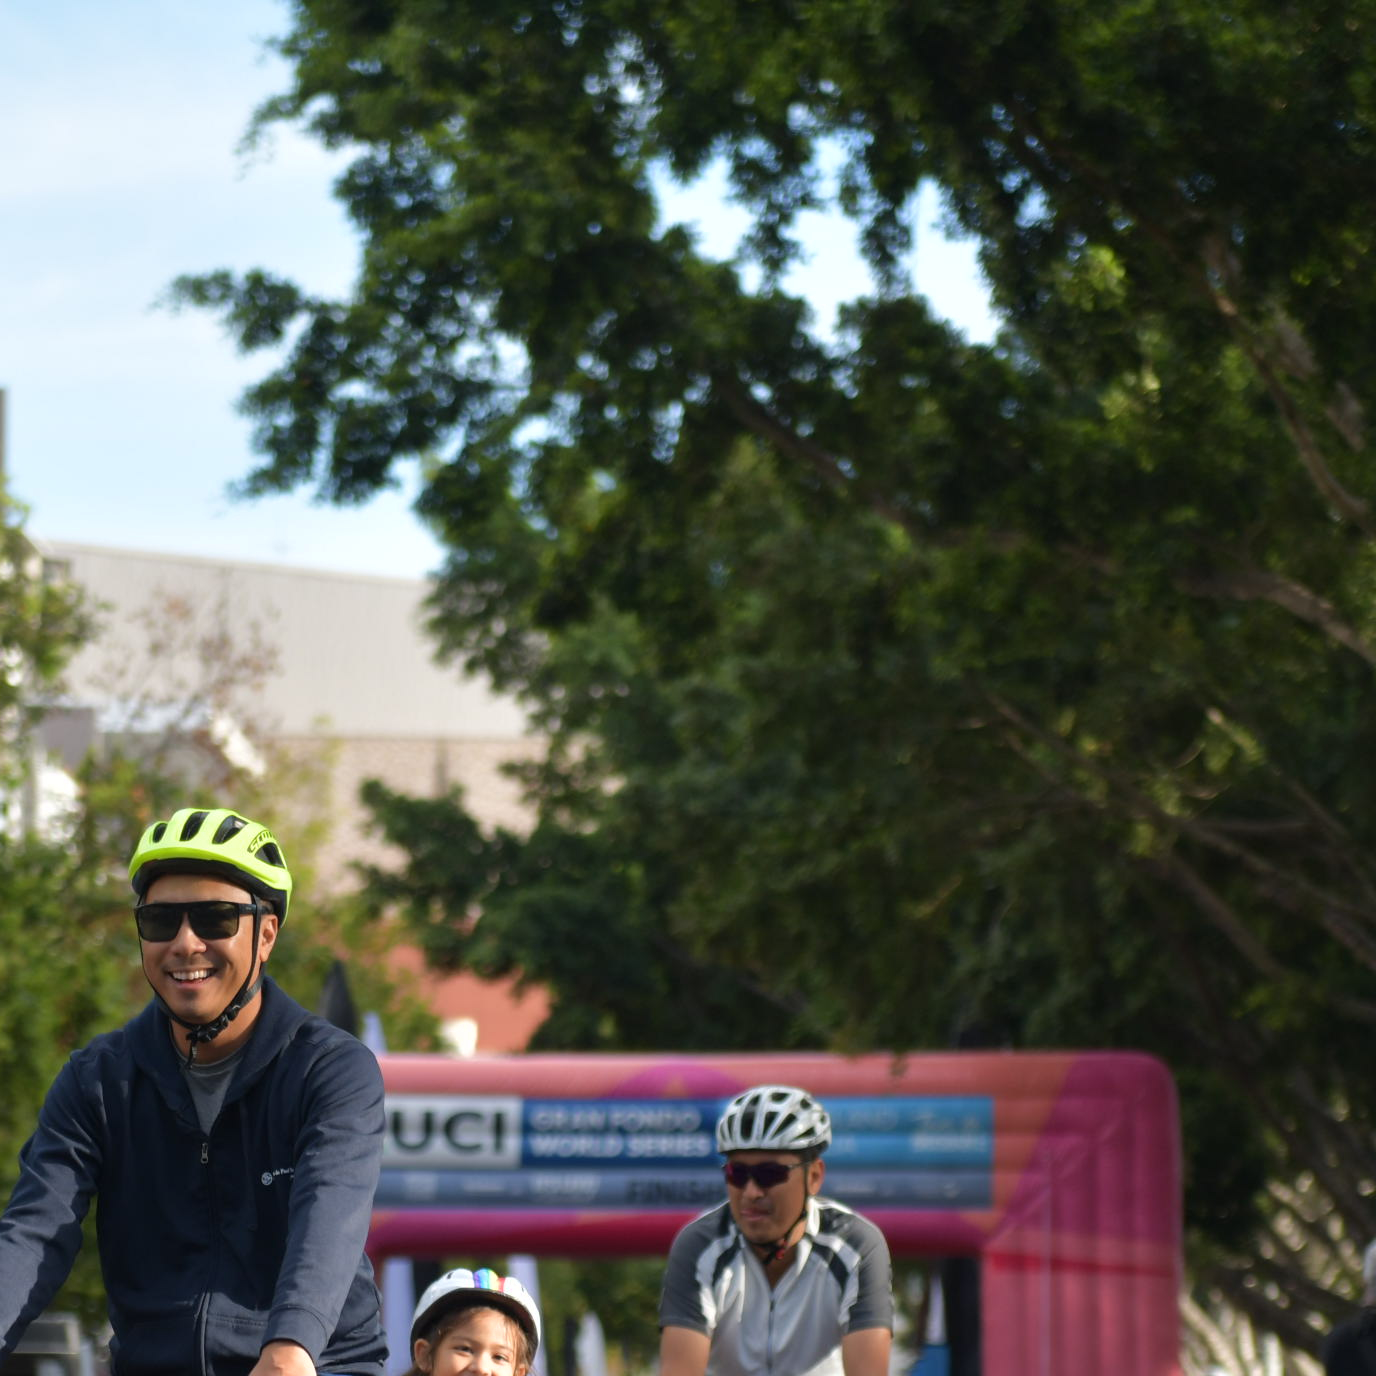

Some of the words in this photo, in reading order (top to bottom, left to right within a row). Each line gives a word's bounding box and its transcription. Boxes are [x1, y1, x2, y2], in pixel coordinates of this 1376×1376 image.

[390, 1110, 507, 1153] UCI
[532, 1106, 605, 1131] GRAN
[610, 1106, 701, 1132] FONDO
[532, 1136, 623, 1157] WORLD
[627, 1135, 712, 1158] SERIES
